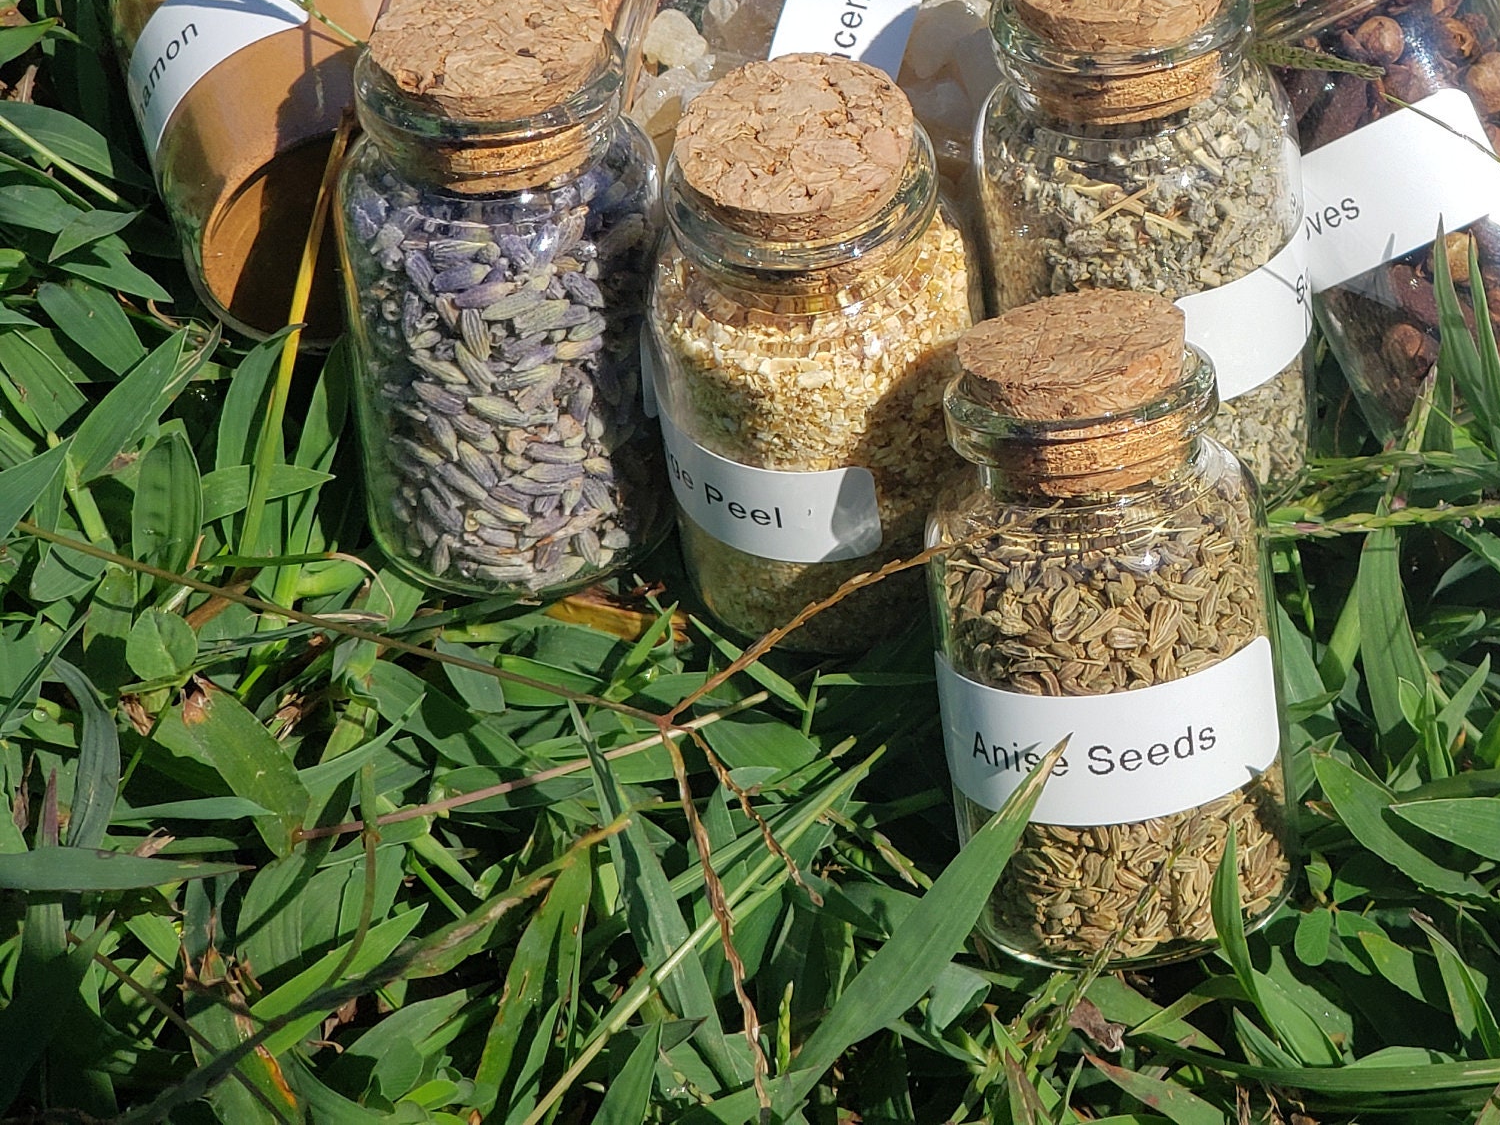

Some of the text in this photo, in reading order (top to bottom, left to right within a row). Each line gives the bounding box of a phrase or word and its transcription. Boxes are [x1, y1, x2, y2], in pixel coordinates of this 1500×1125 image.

[1304, 197, 1360, 241] ves
[703, 481, 783, 529] Peel
[1087, 725, 1217, 775] Seeds
